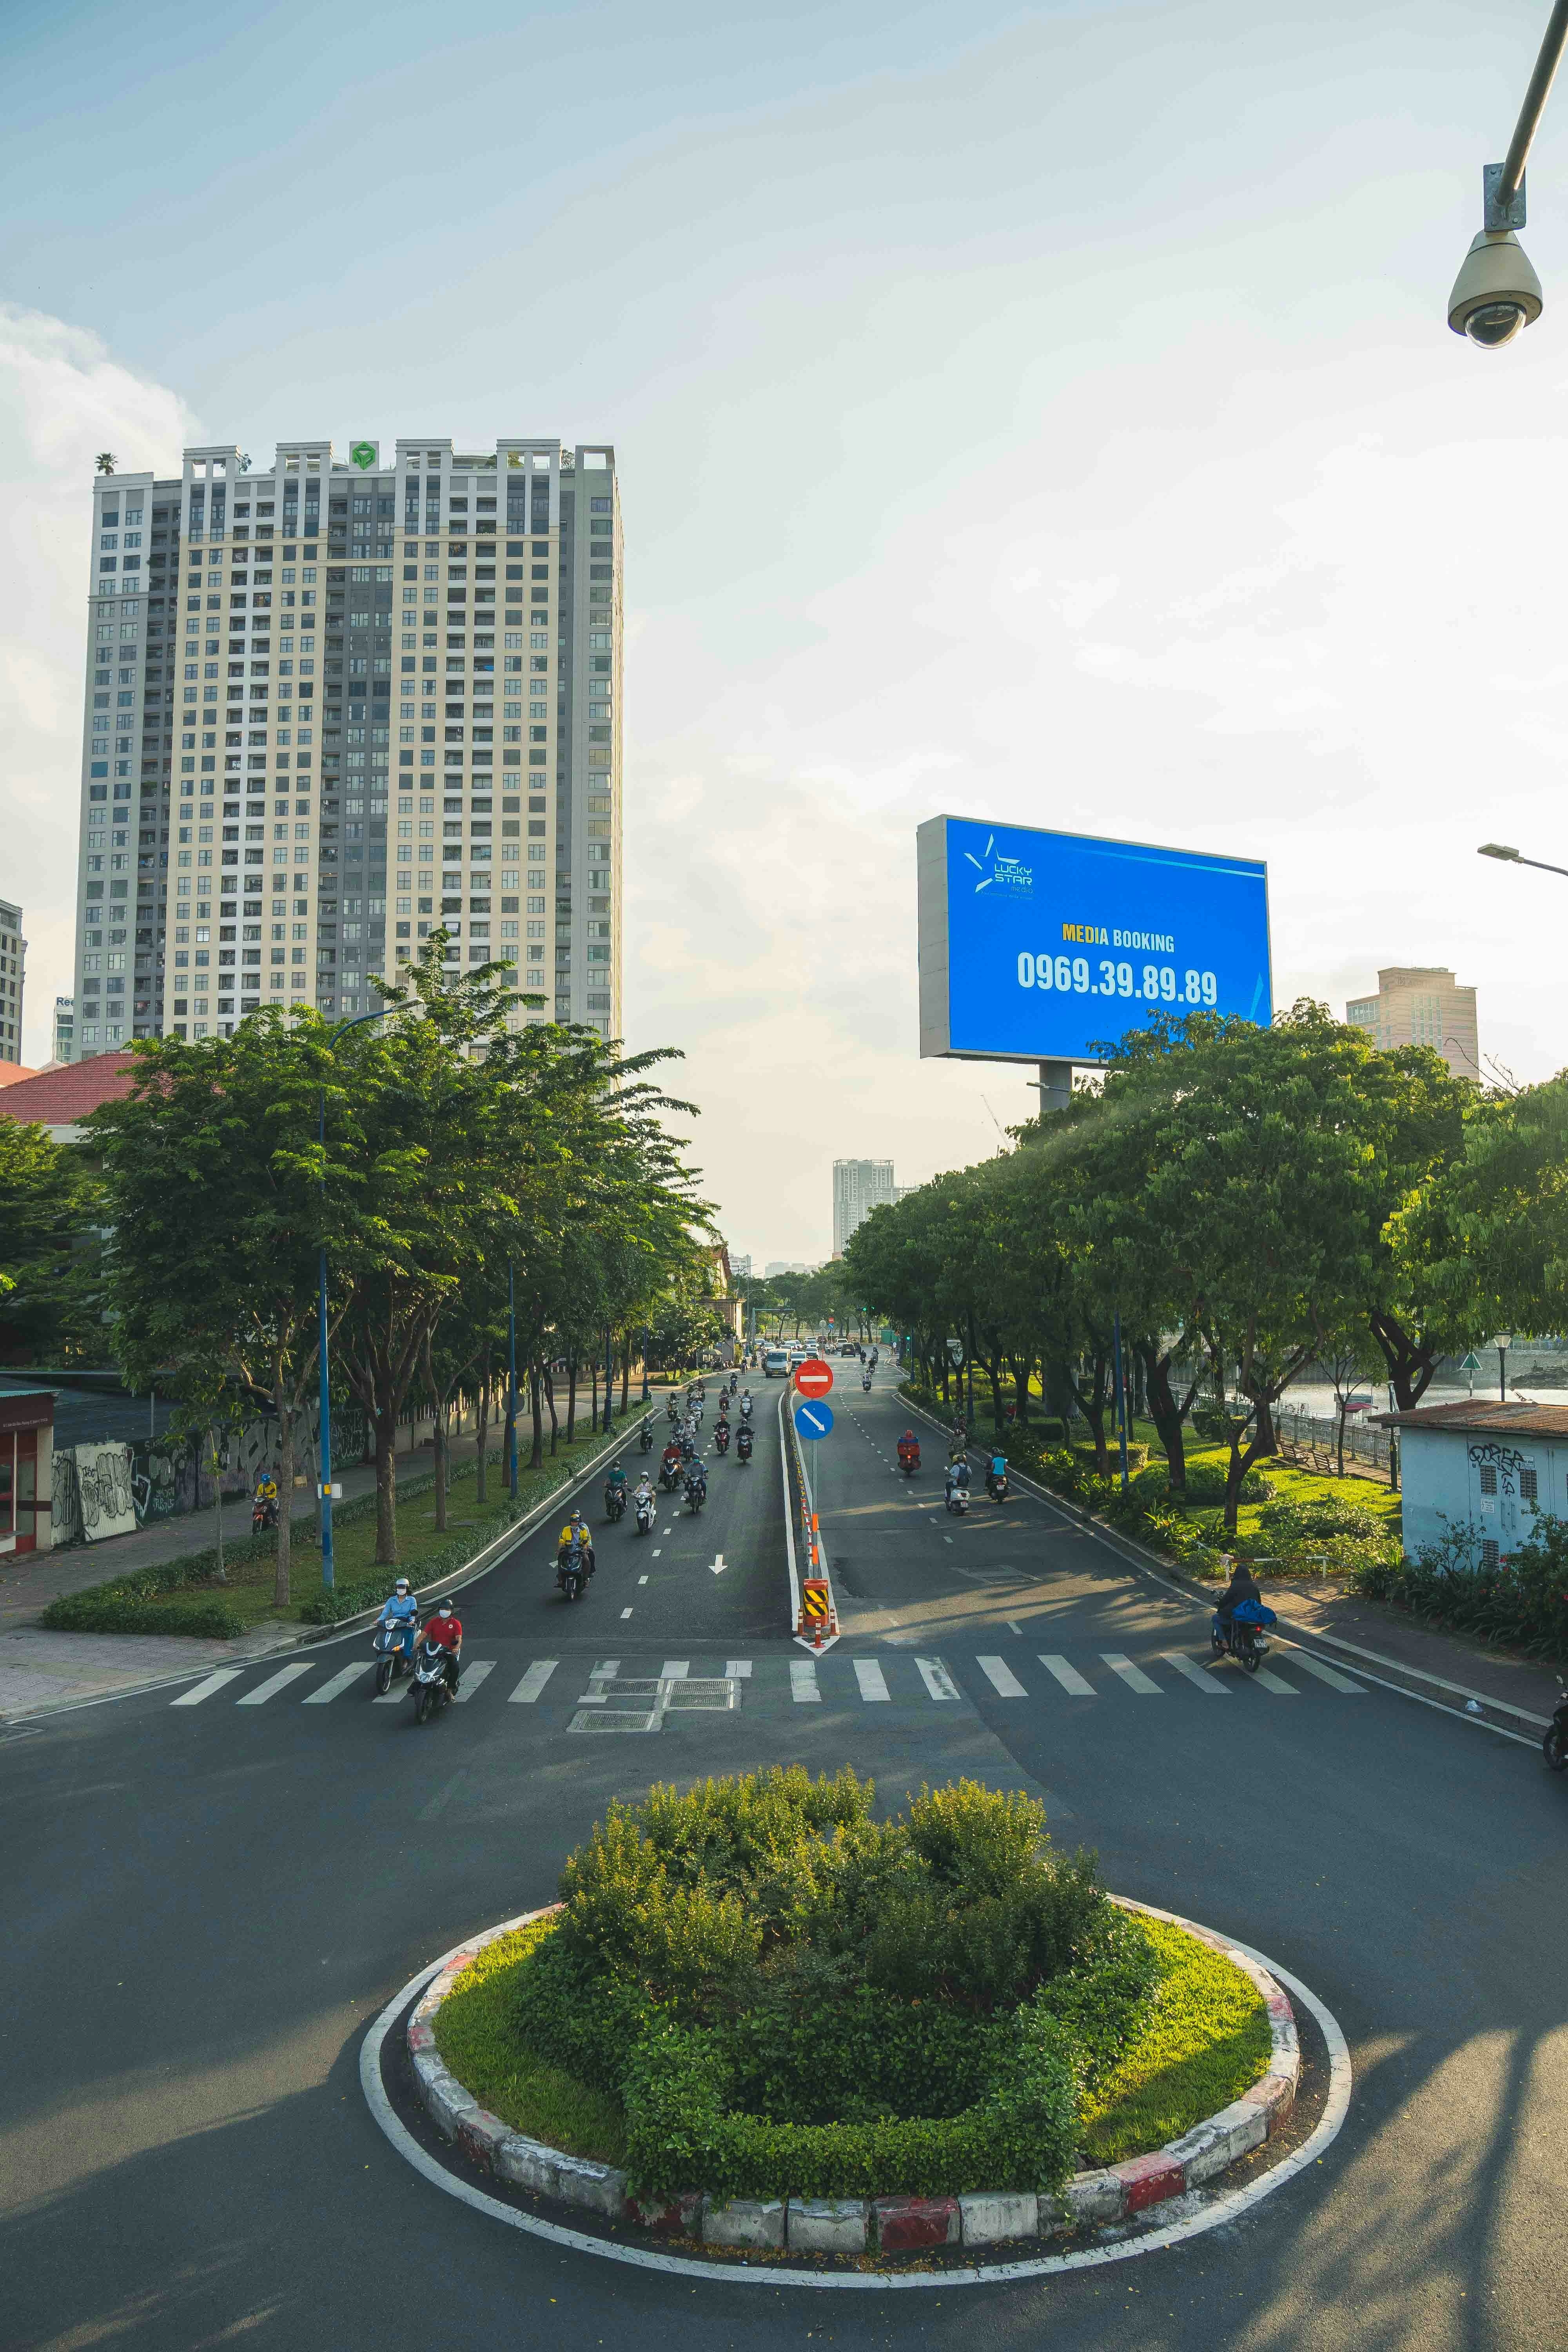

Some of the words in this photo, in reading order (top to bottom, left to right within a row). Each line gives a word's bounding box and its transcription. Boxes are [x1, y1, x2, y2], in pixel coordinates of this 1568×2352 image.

[995, 864, 1032, 875] LUCKY
[995, 873, 1033, 886] STAR
[1063, 923, 1109, 945] MEDIA
[1113, 929, 1174, 953] BOOKING
[1018, 952, 1217, 1005] 0969.39.89.89
